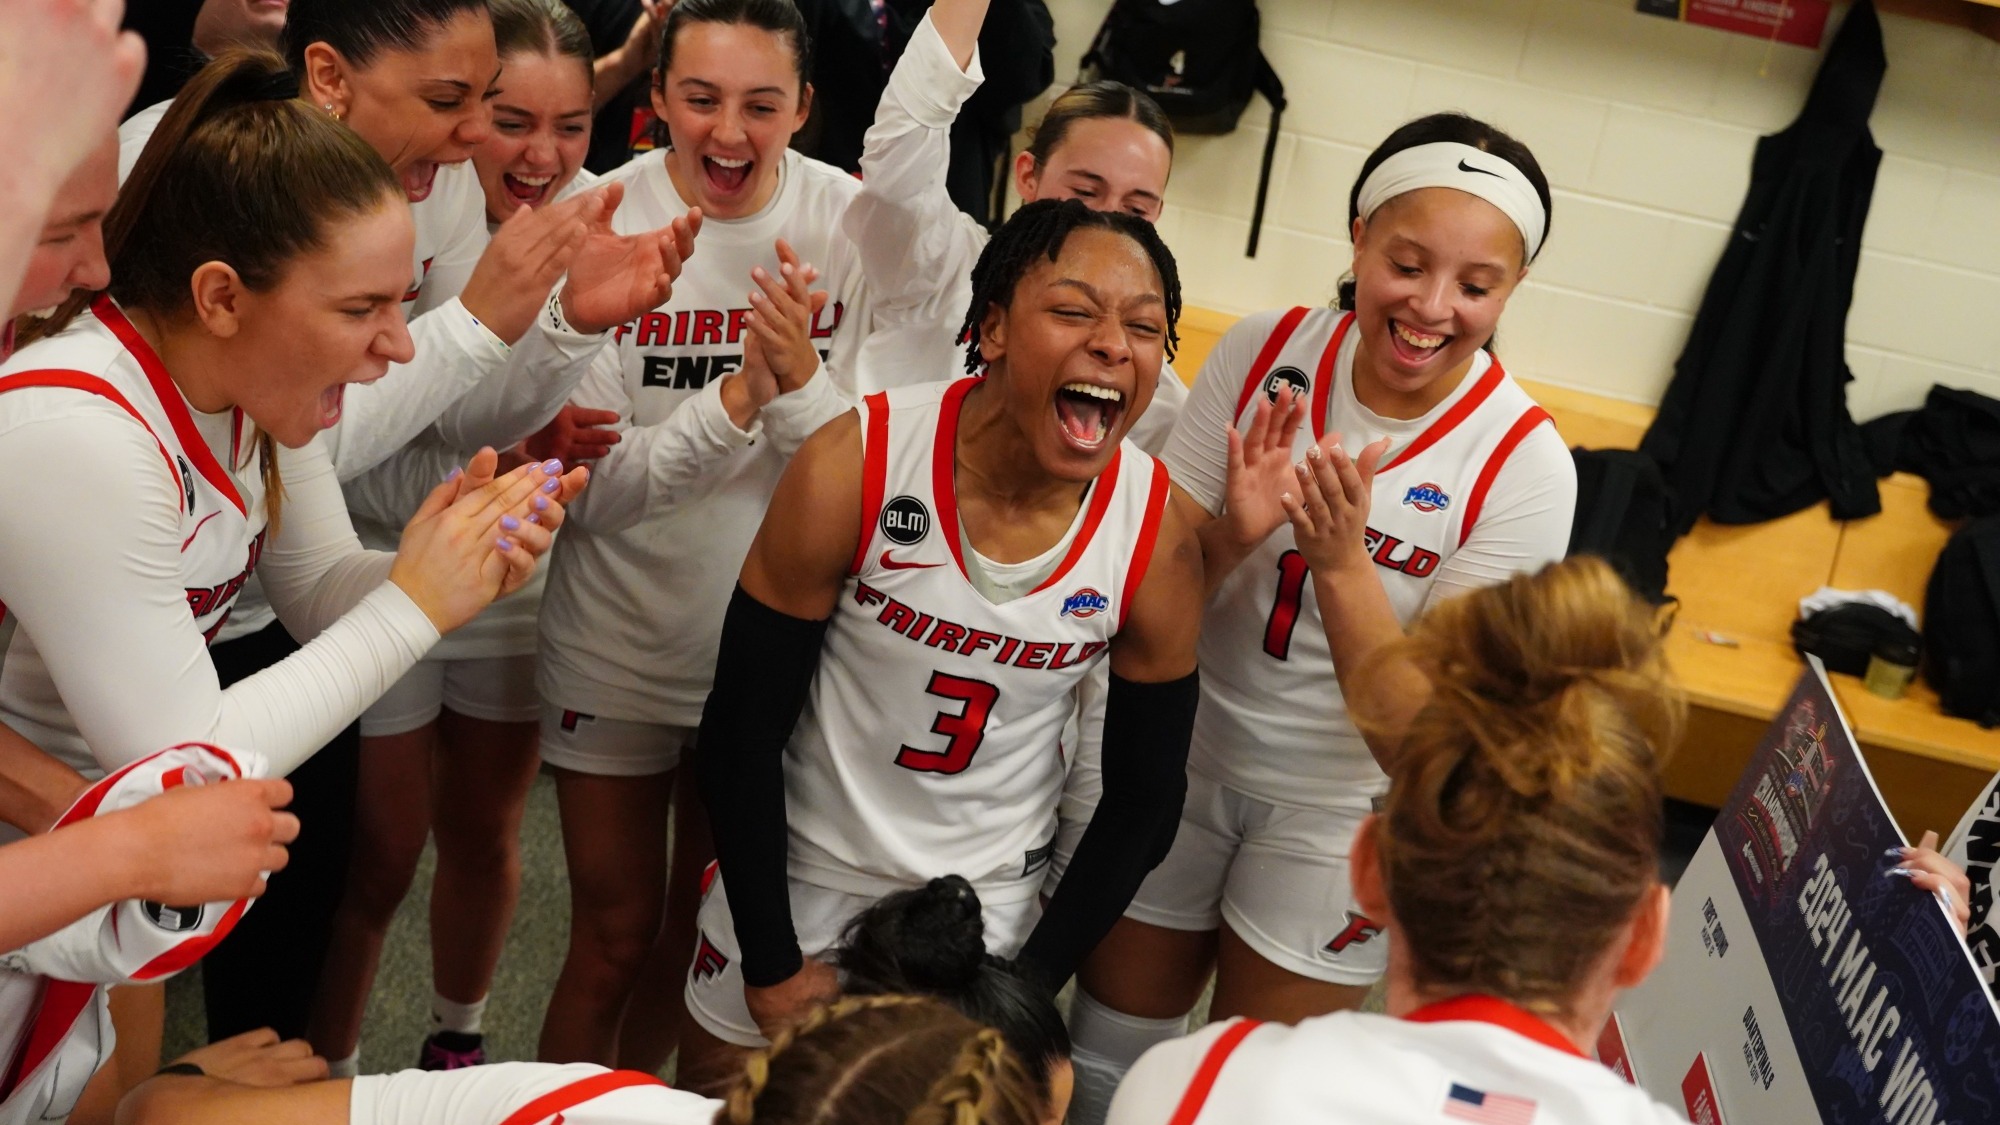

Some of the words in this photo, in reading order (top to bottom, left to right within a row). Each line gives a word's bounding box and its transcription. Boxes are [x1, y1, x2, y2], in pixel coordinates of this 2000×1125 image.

[885, 510, 924, 533] BLM
[1403, 487, 1450, 511] MAAC
[854, 579, 1109, 670] FAIRFIELD
[1060, 594, 1109, 617] MAAC
[894, 669, 1000, 775] 3
[1323, 911, 1385, 955] F
[1798, 852, 1852, 967] 2024
[1828, 928, 1900, 1072] MAAC
[1878, 1036, 1946, 1125] WO
[1742, 1005, 1775, 1091] QUARTERFINALS
